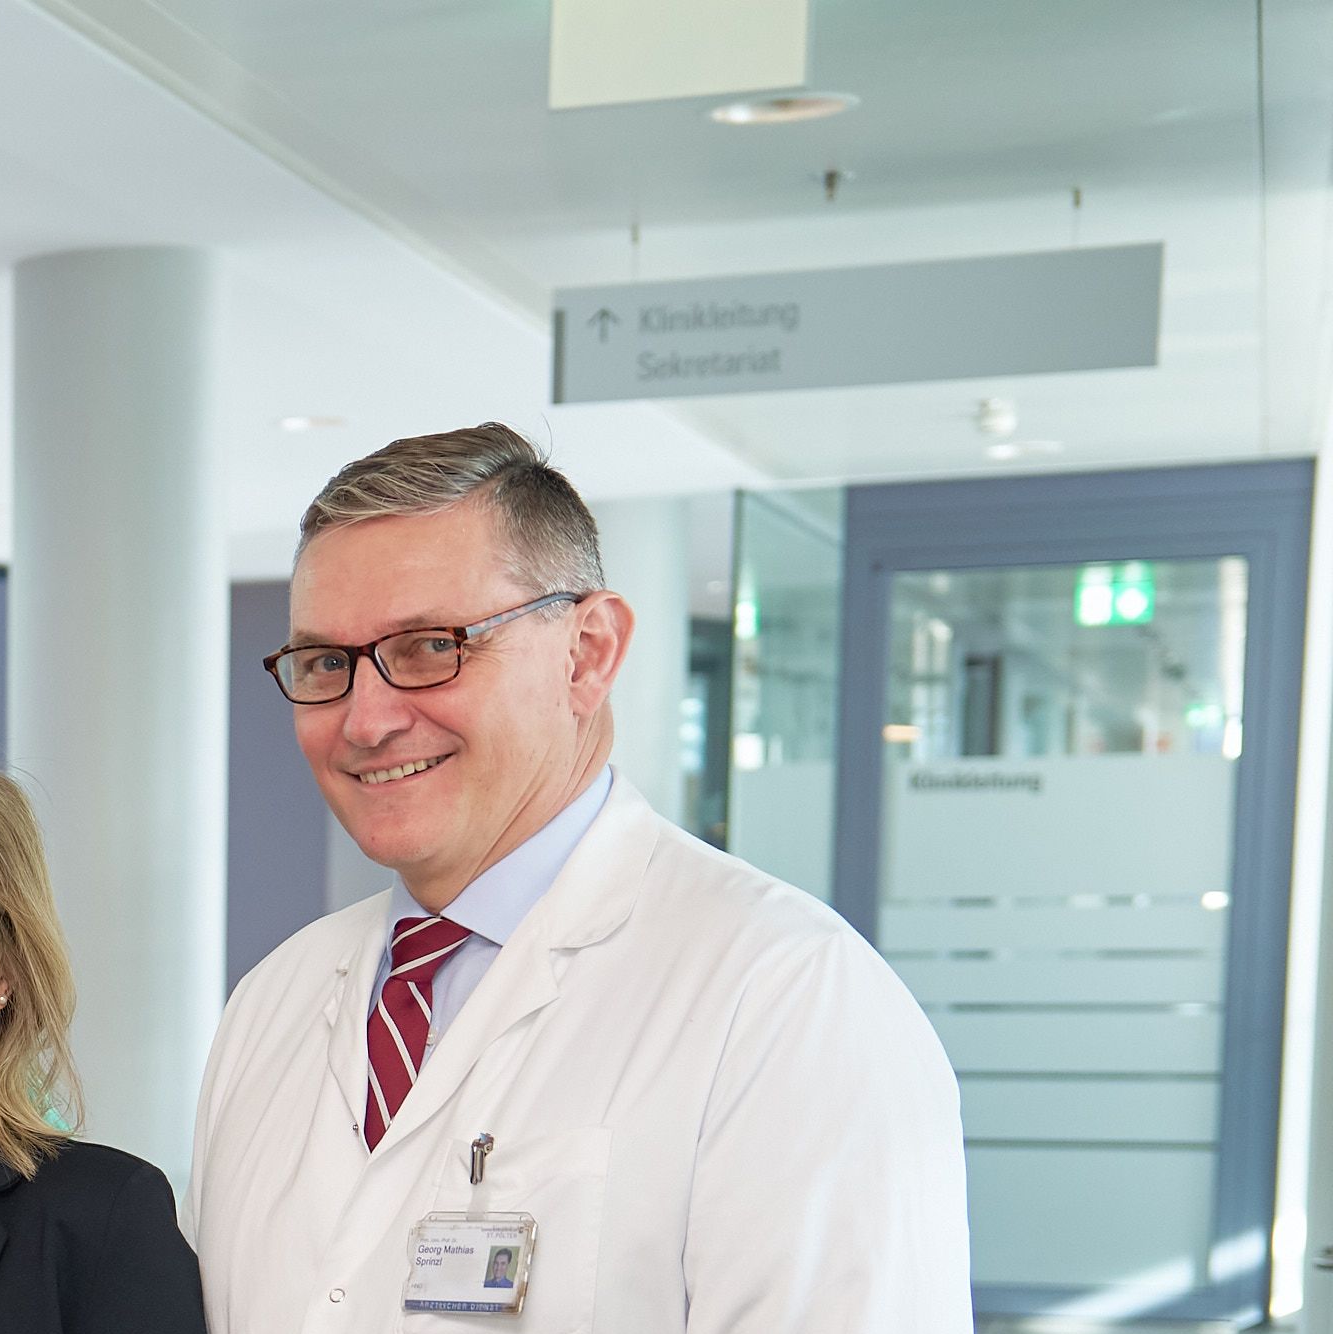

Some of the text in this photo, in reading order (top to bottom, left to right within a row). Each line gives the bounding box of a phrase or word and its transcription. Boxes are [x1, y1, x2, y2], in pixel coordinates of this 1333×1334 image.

[637, 301, 800, 335] Klinikleitung
[636, 347, 783, 381] Sekretariat
[418, 1245, 474, 1255] Georg Mathias
